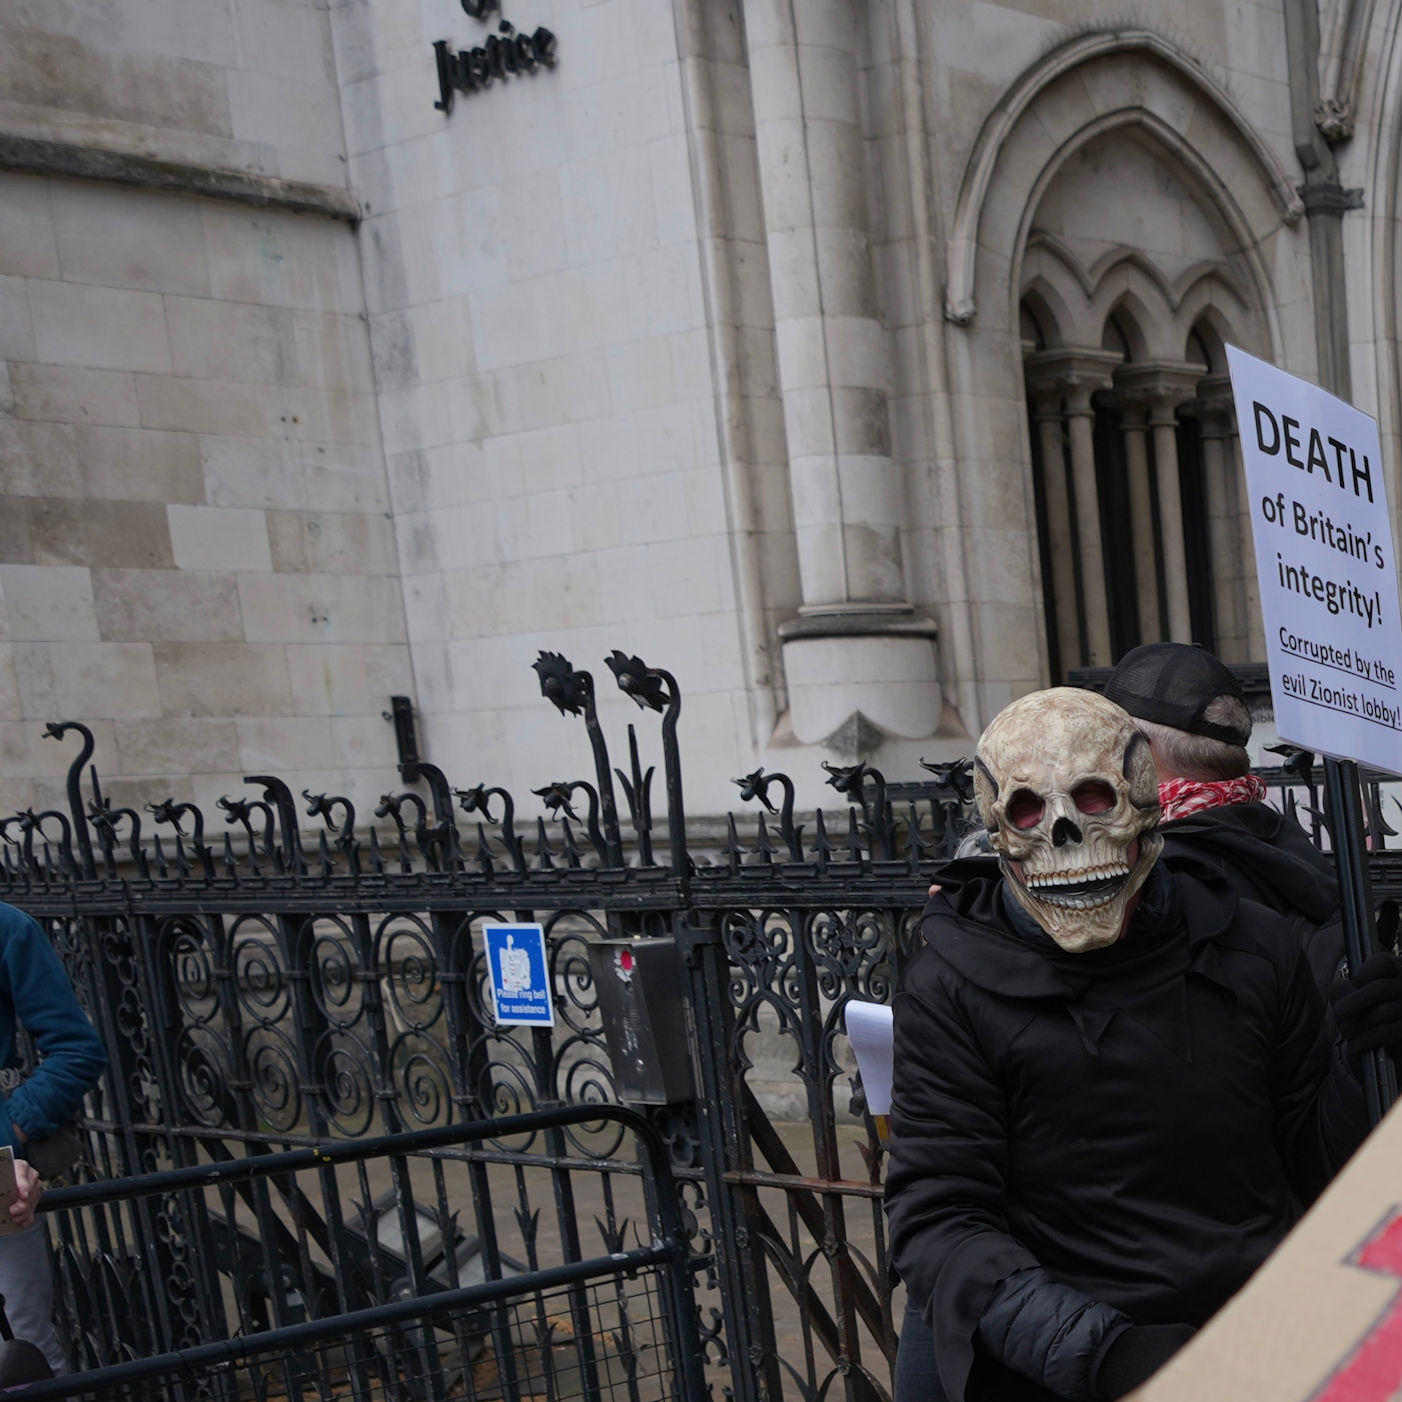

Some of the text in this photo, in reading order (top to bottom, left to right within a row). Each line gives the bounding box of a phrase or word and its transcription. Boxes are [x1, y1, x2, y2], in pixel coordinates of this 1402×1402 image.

[432, 20, 558, 117] Justice
[1253, 400, 1374, 503] DEATH
[1262, 491, 1385, 569] of Britain's
[1277, 553, 1383, 628] integrity!
[1280, 627, 1396, 686] Corrupted by the
[1282, 673, 1402, 728] evil Zionist lobby!
[500, 1003, 546, 1015] for assistance
